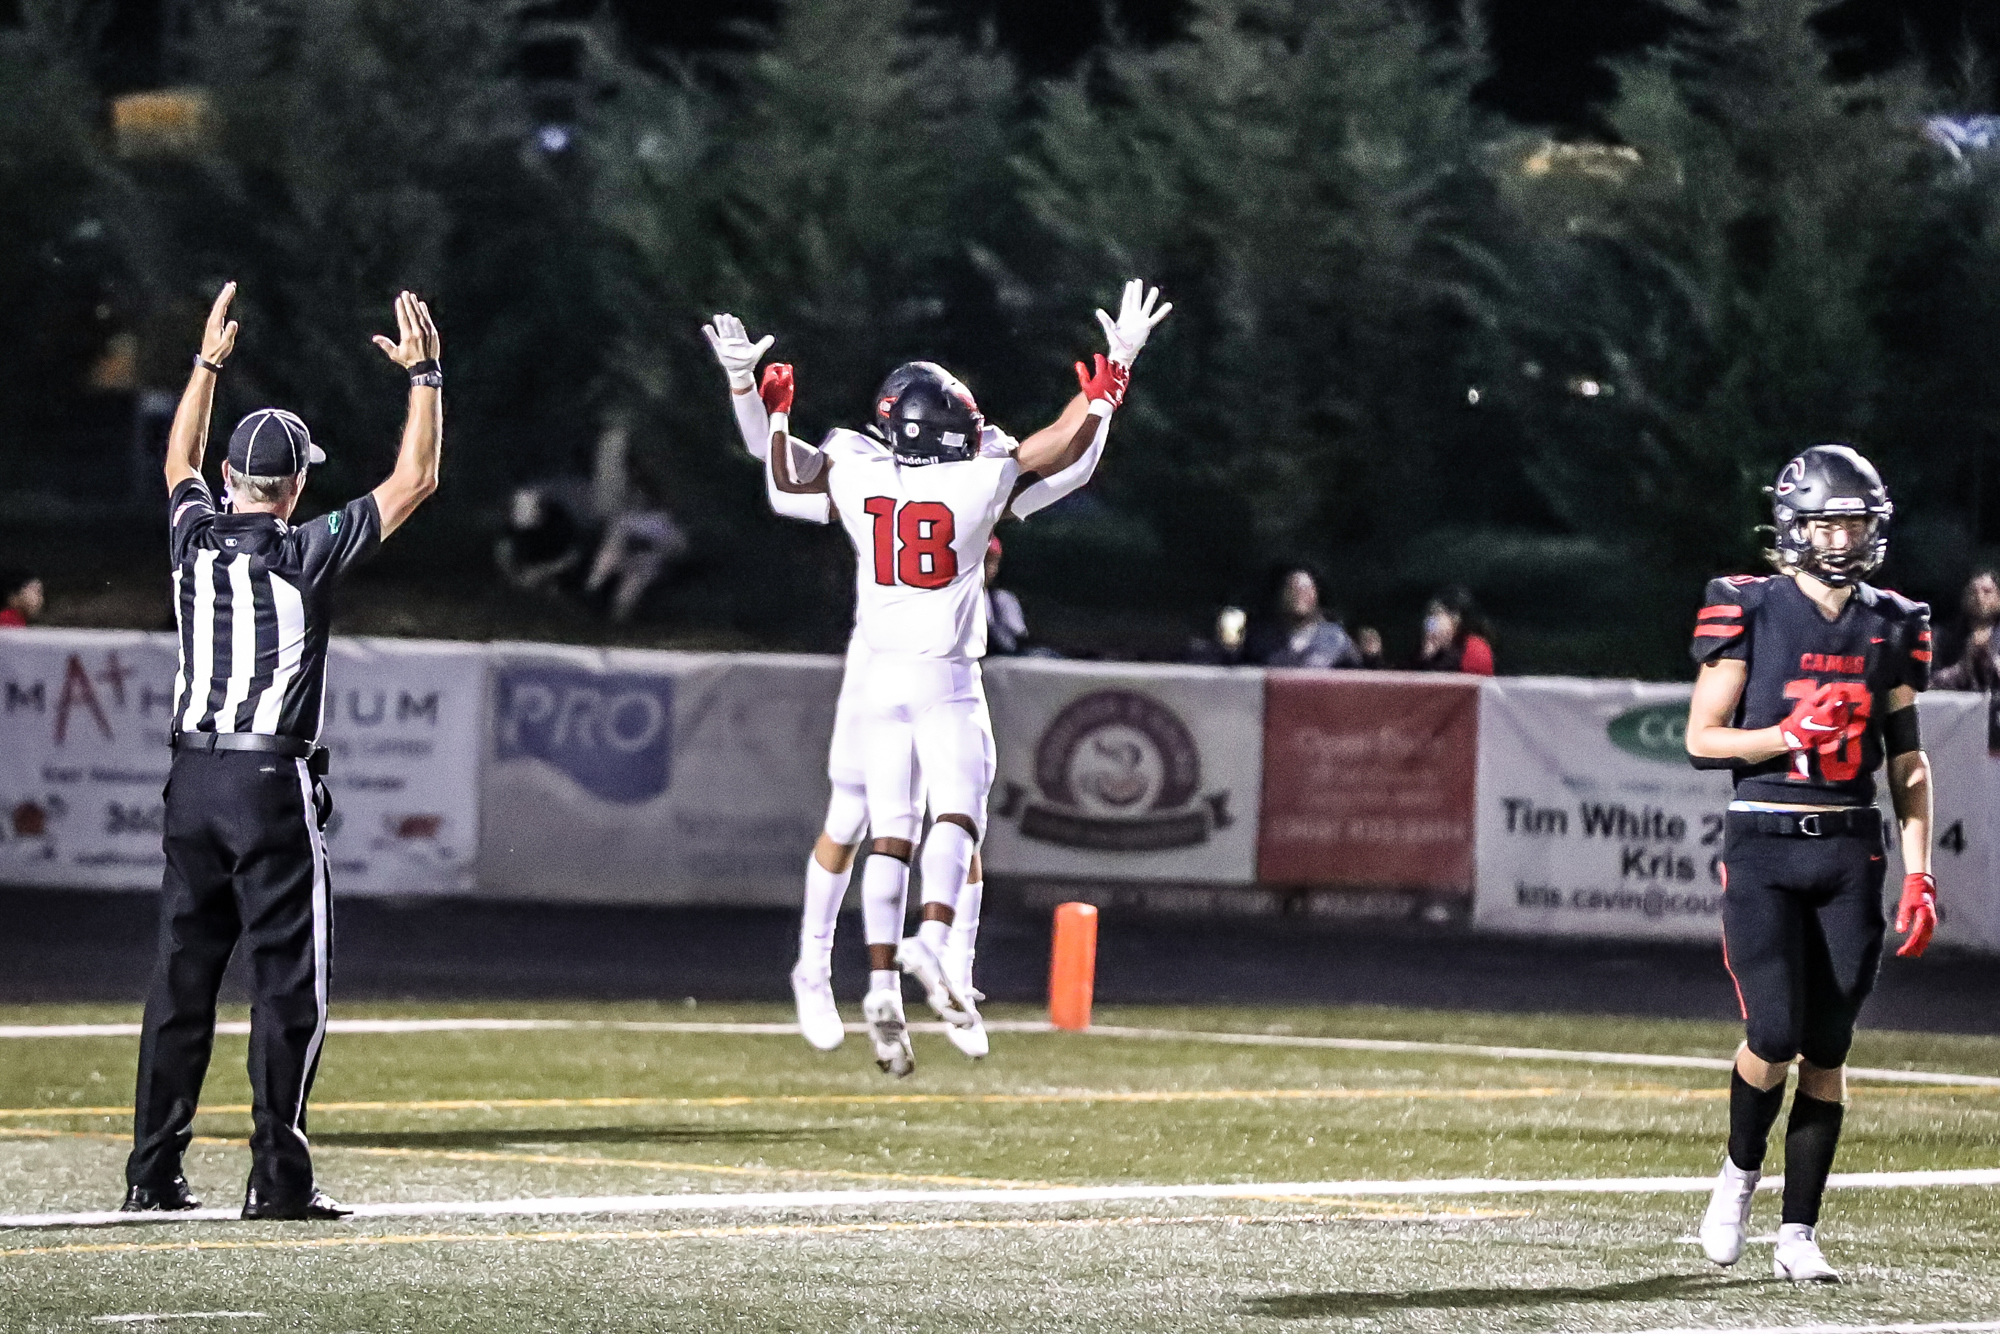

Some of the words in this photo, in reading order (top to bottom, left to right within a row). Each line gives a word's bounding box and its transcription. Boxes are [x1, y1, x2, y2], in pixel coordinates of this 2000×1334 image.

[864, 496, 959, 590] 18
[503, 682, 664, 753] PRO
[1501, 797, 1569, 834] Tim
[1579, 800, 1687, 843] White
[1620, 847, 1696, 882] Kris
